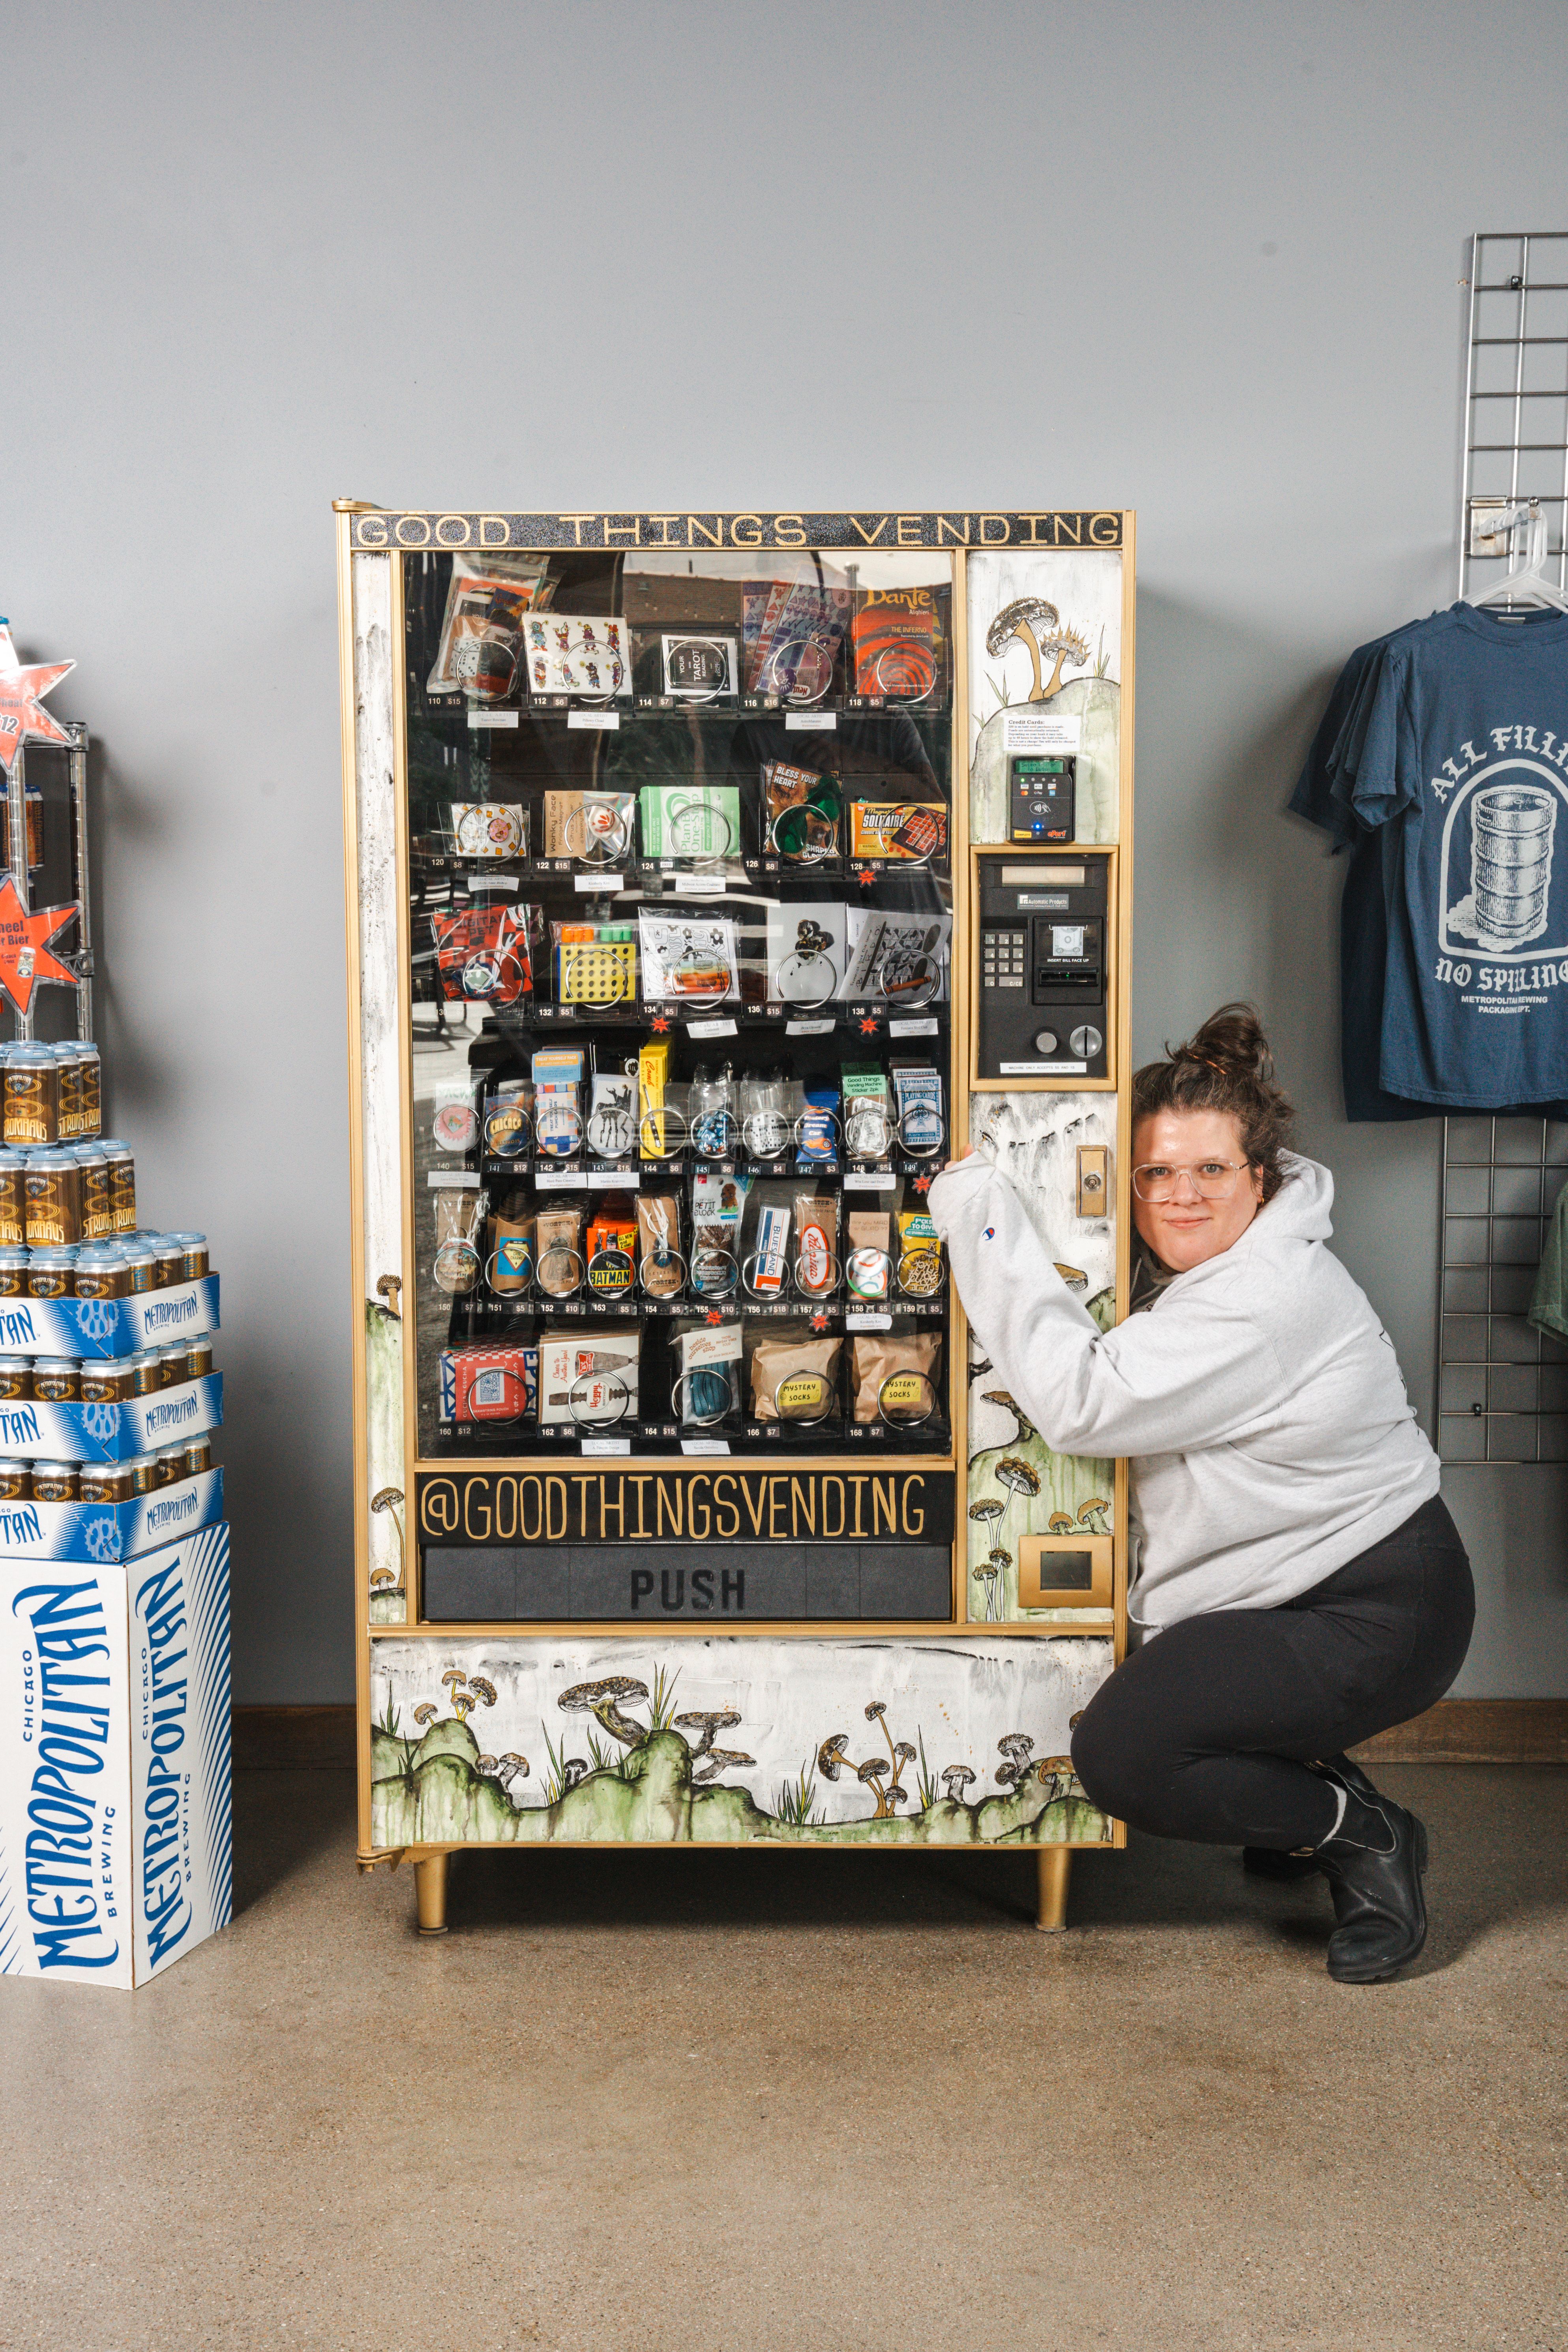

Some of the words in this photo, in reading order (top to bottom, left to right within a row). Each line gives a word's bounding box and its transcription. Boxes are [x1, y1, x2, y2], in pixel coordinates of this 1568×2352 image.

[356, 516, 510, 547] GOOD
[559, 514, 806, 547] THINGS
[850, 514, 1118, 545] VENDING
[860, 584, 932, 615] Dante
[692, 649, 701, 681] TAROT
[776, 766, 799, 780] BLESS
[800, 772, 817, 785] YOUR
[1431, 740, 1487, 804] ALL
[1490, 725, 1568, 776] FILLI
[774, 775, 798, 789] HEART
[862, 815, 905, 828] SOLIAIRE
[7, 935, 29, 945] Bier
[468, 927, 492, 937] PET
[1435, 958, 1472, 987] NO
[8, 1074, 32, 1084] METROPOLITAN
[645, 1060, 656, 1087] Comb
[695, 1201, 716, 1210] PETIT
[767, 1225, 781, 1276] BLUESBAND
[32, 1275, 56, 1286] METROPOLITAN
[590, 1271, 630, 1285] BATMAN
[144, 1291, 198, 1334] METROPOLITAN
[561, 1349, 570, 1362] Year!
[688, 1341, 711, 1360] ourselves
[689, 1337, 706, 1350] beside
[783, 1383, 816, 1392] MYSTERY
[147, 1486, 198, 1535] METROPOLITAN
[422, 1475, 924, 1539] @GOODTHINGSVENDING
[631, 1569, 745, 1611] PUSH
[23, 1650, 33, 1742] CHICAGO
[12, 1578, 119, 1970] METROPOLITAN
[135, 1555, 193, 1969] METROPOLITAN
[107, 1805, 116, 1917] BREWING
